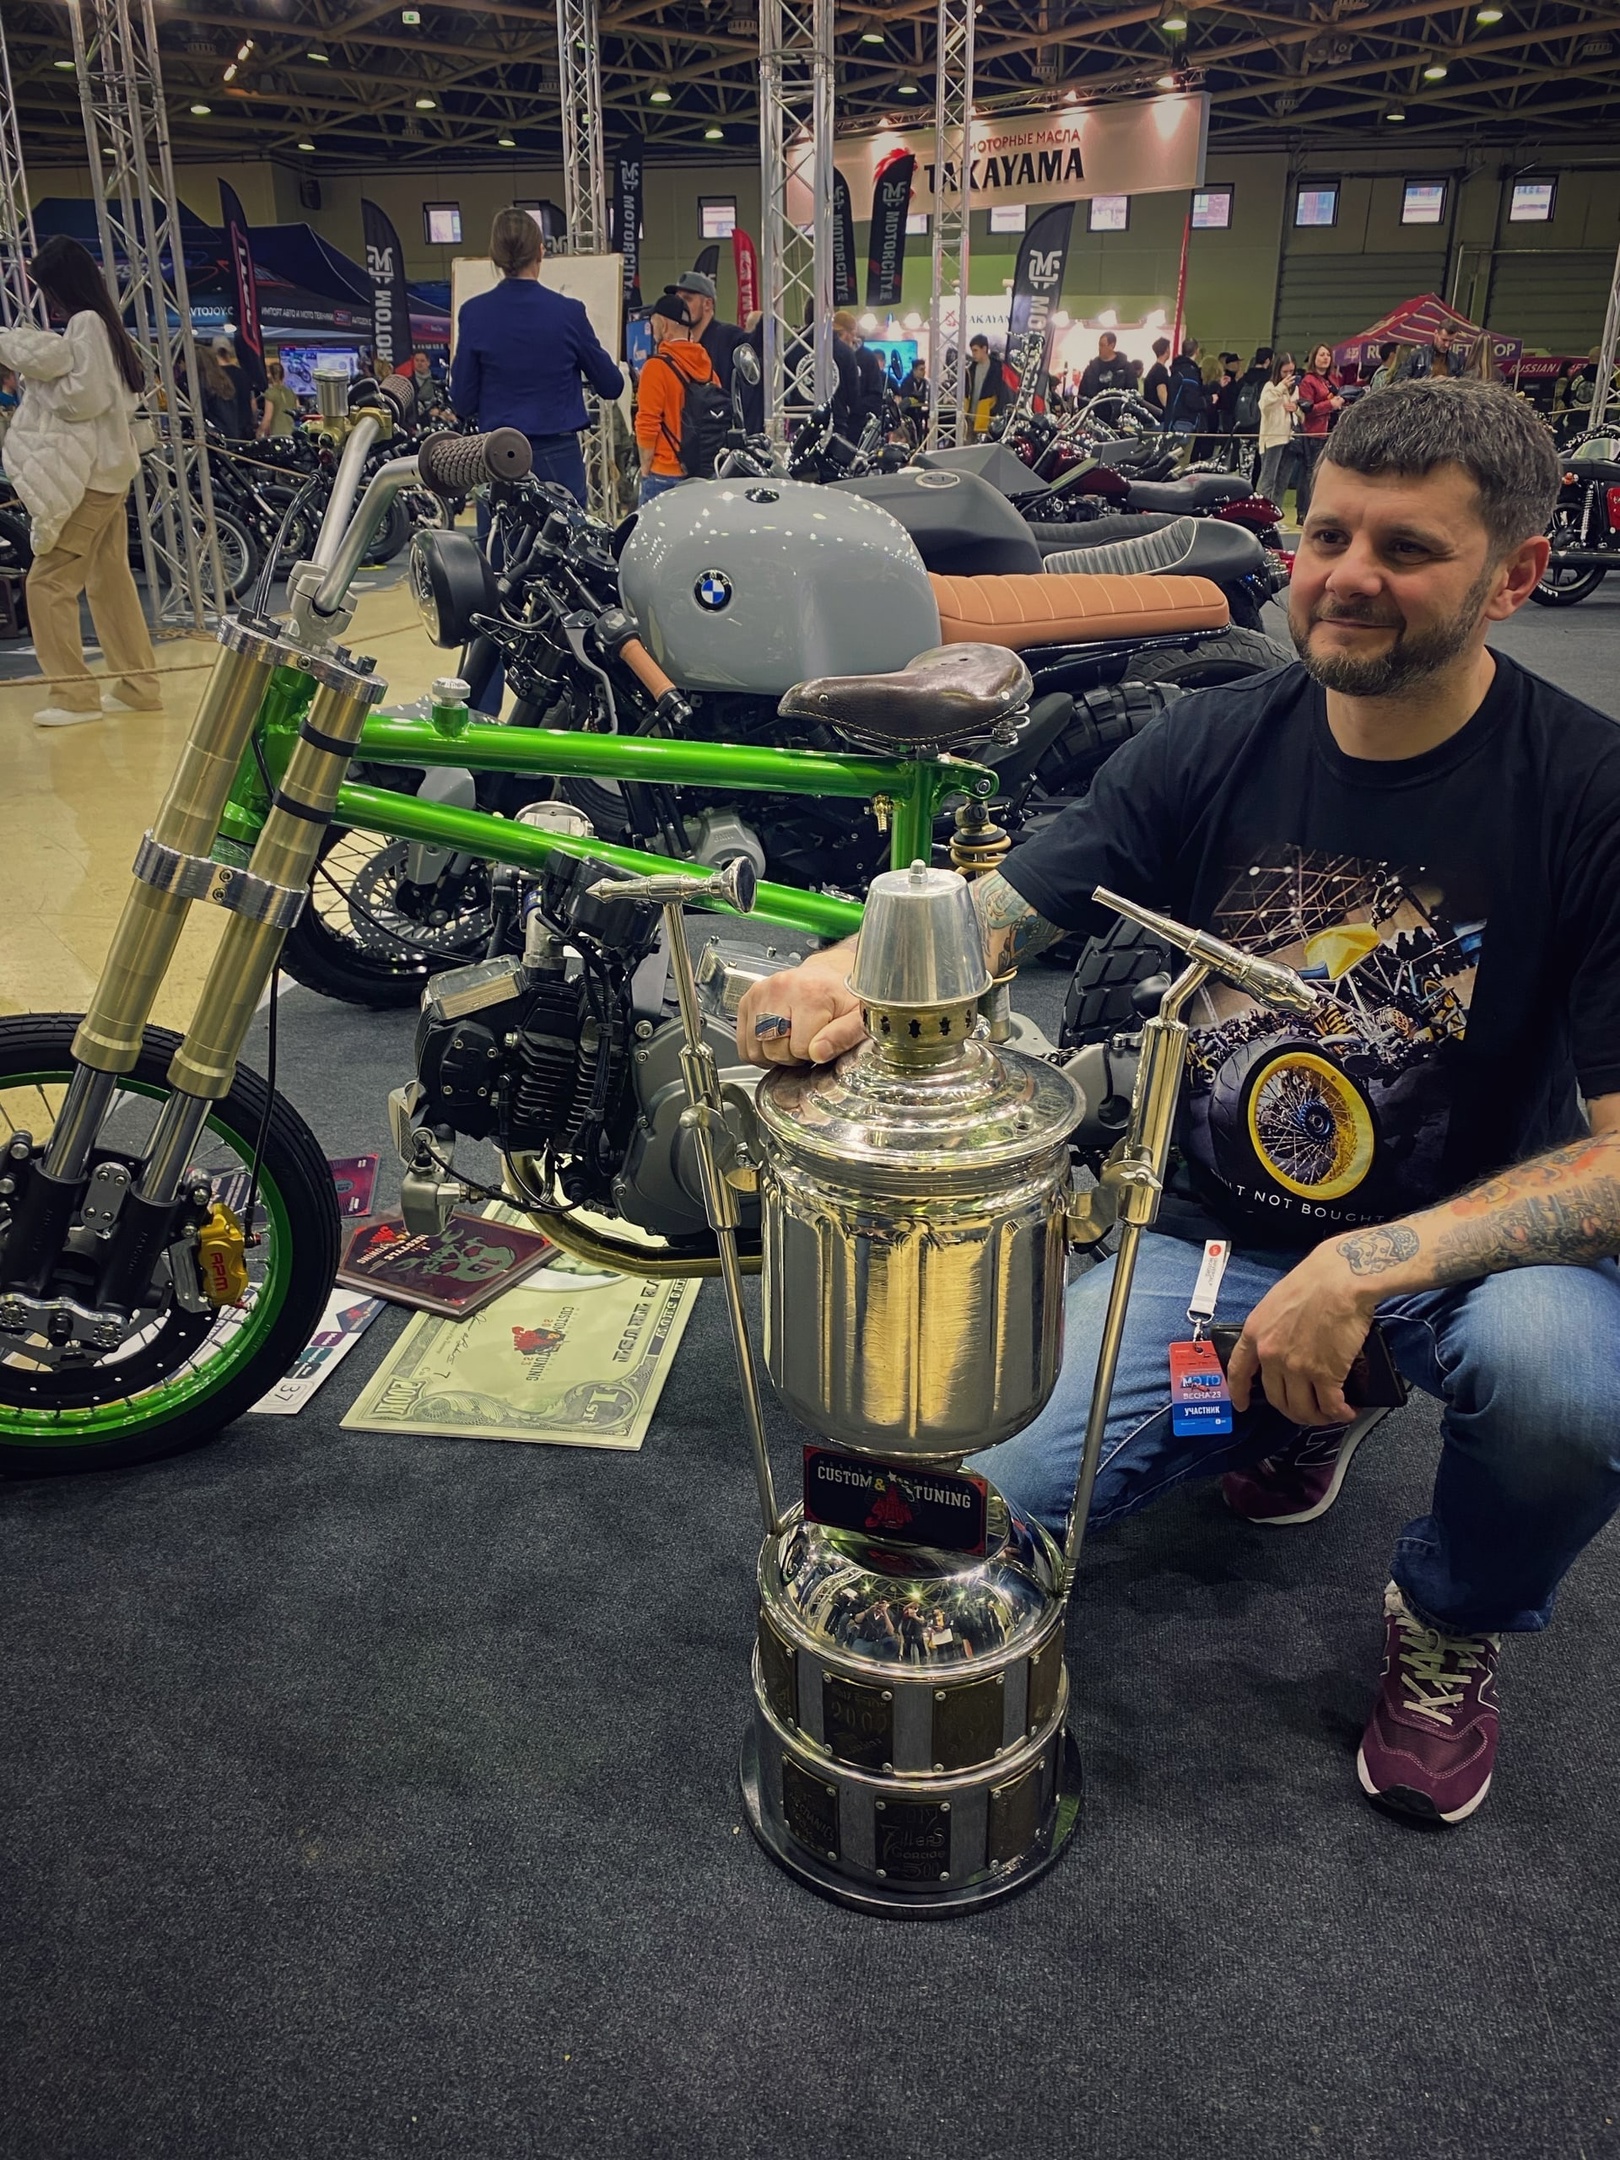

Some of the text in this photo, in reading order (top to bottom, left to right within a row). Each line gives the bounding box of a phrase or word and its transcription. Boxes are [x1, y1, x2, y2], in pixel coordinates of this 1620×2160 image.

[1036, 129, 1080, 144] МАСЛА
[1253, 1190, 1293, 1209] NOT
[1301, 1203, 1386, 1222] BOUGHT
[210, 1252, 229, 1291] RPM
[553, 1306, 575, 1333] CUSTOM
[612, 1303, 652, 1363] TRUST
[526, 1349, 550, 1382] TUNING
[274, 1385, 301, 1401] 37
[1184, 1405, 1220, 1416] УЧАСТНИК
[817, 1466, 971, 1509] CUSTOM & TUNING
